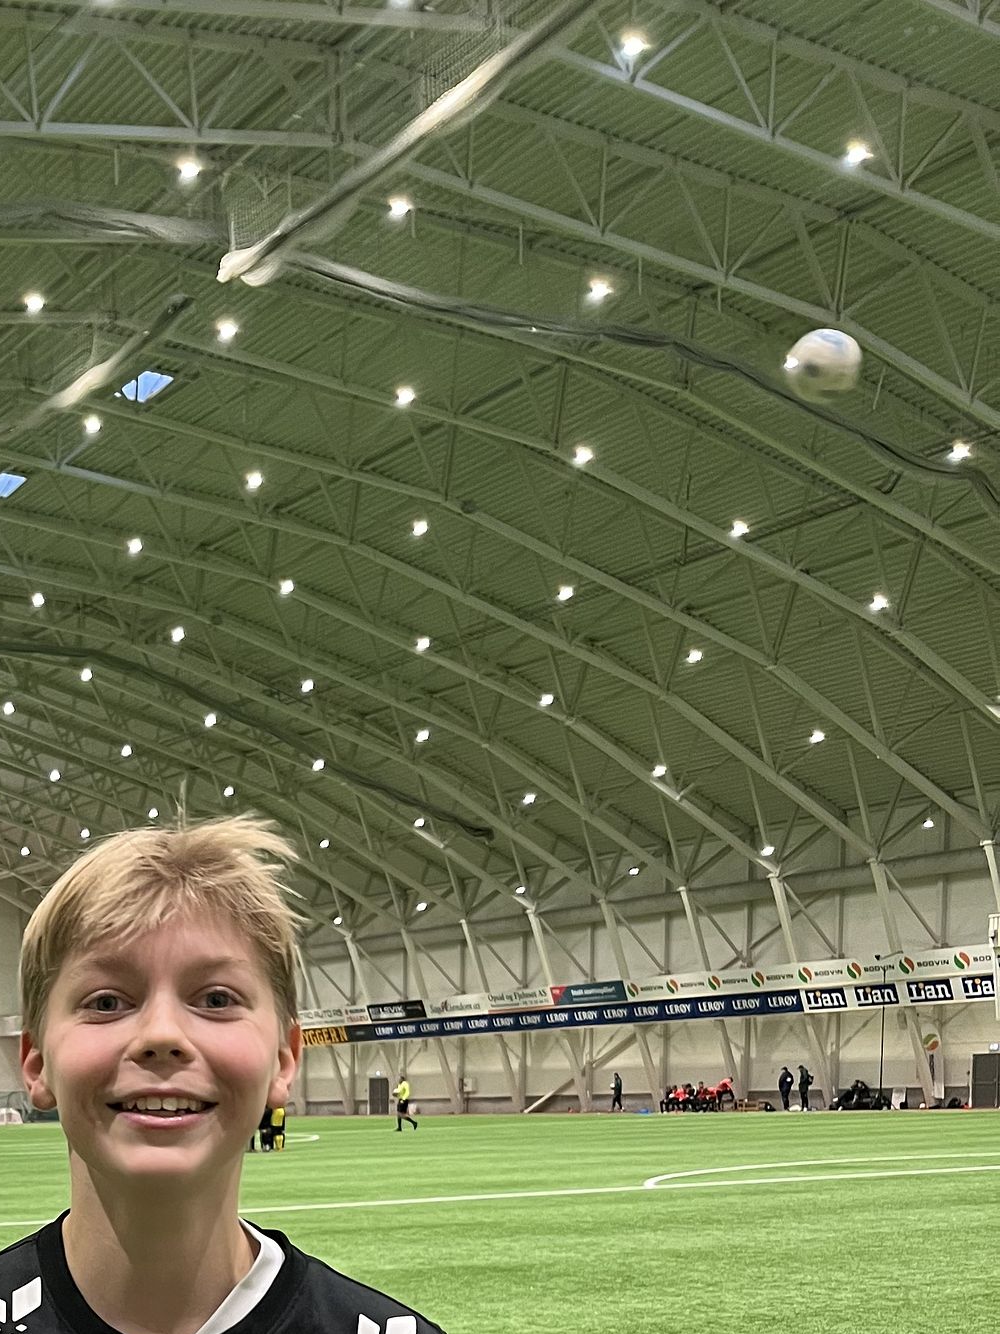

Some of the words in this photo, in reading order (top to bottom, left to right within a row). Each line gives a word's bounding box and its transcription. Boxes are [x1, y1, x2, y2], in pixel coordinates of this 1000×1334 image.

[917, 960, 950, 968] SODVIN
[814, 969, 843, 977] SODVIN
[909, 982, 951, 1000] Lian
[965, 978, 994, 996] Lia
[768, 995, 797, 1007] LERØY
[807, 991, 845, 1007] Lian
[857, 987, 896, 1004] Lian
[665, 1004, 691, 1015] LERØY
[698, 1001, 725, 1012] LERØY
[732, 998, 760, 1010] LERØY
[603, 1008, 627, 1019] LERØY
[634, 1006, 659, 1017] LERØY
